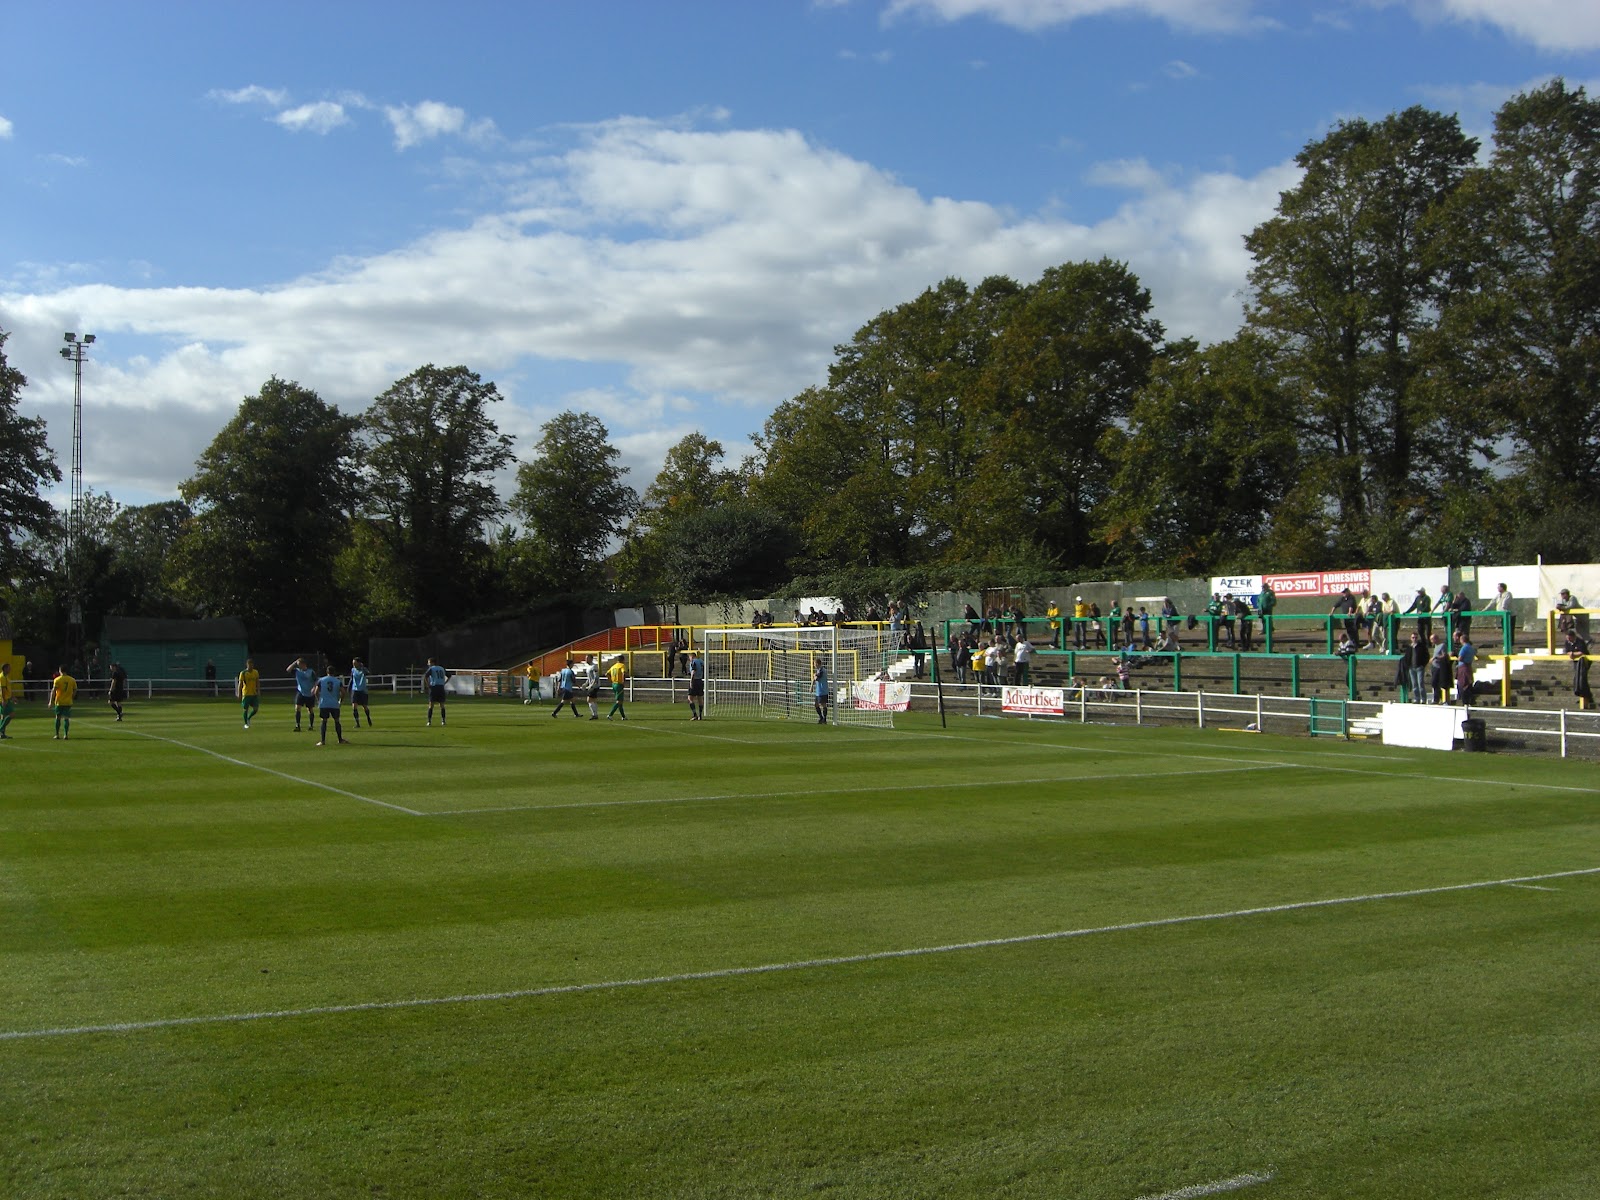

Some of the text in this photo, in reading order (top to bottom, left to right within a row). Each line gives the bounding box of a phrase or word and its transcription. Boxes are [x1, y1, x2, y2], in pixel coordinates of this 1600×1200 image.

[1220, 578, 1252, 588] AZTEK
[1323, 572, 1369, 583] ADHESIVES
[1274, 579, 1317, 591] EVO-STIK
[1323, 584, 1329, 593] &
[327, 681, 334, 692] 3
[1005, 689, 1061, 706] Advertiser
